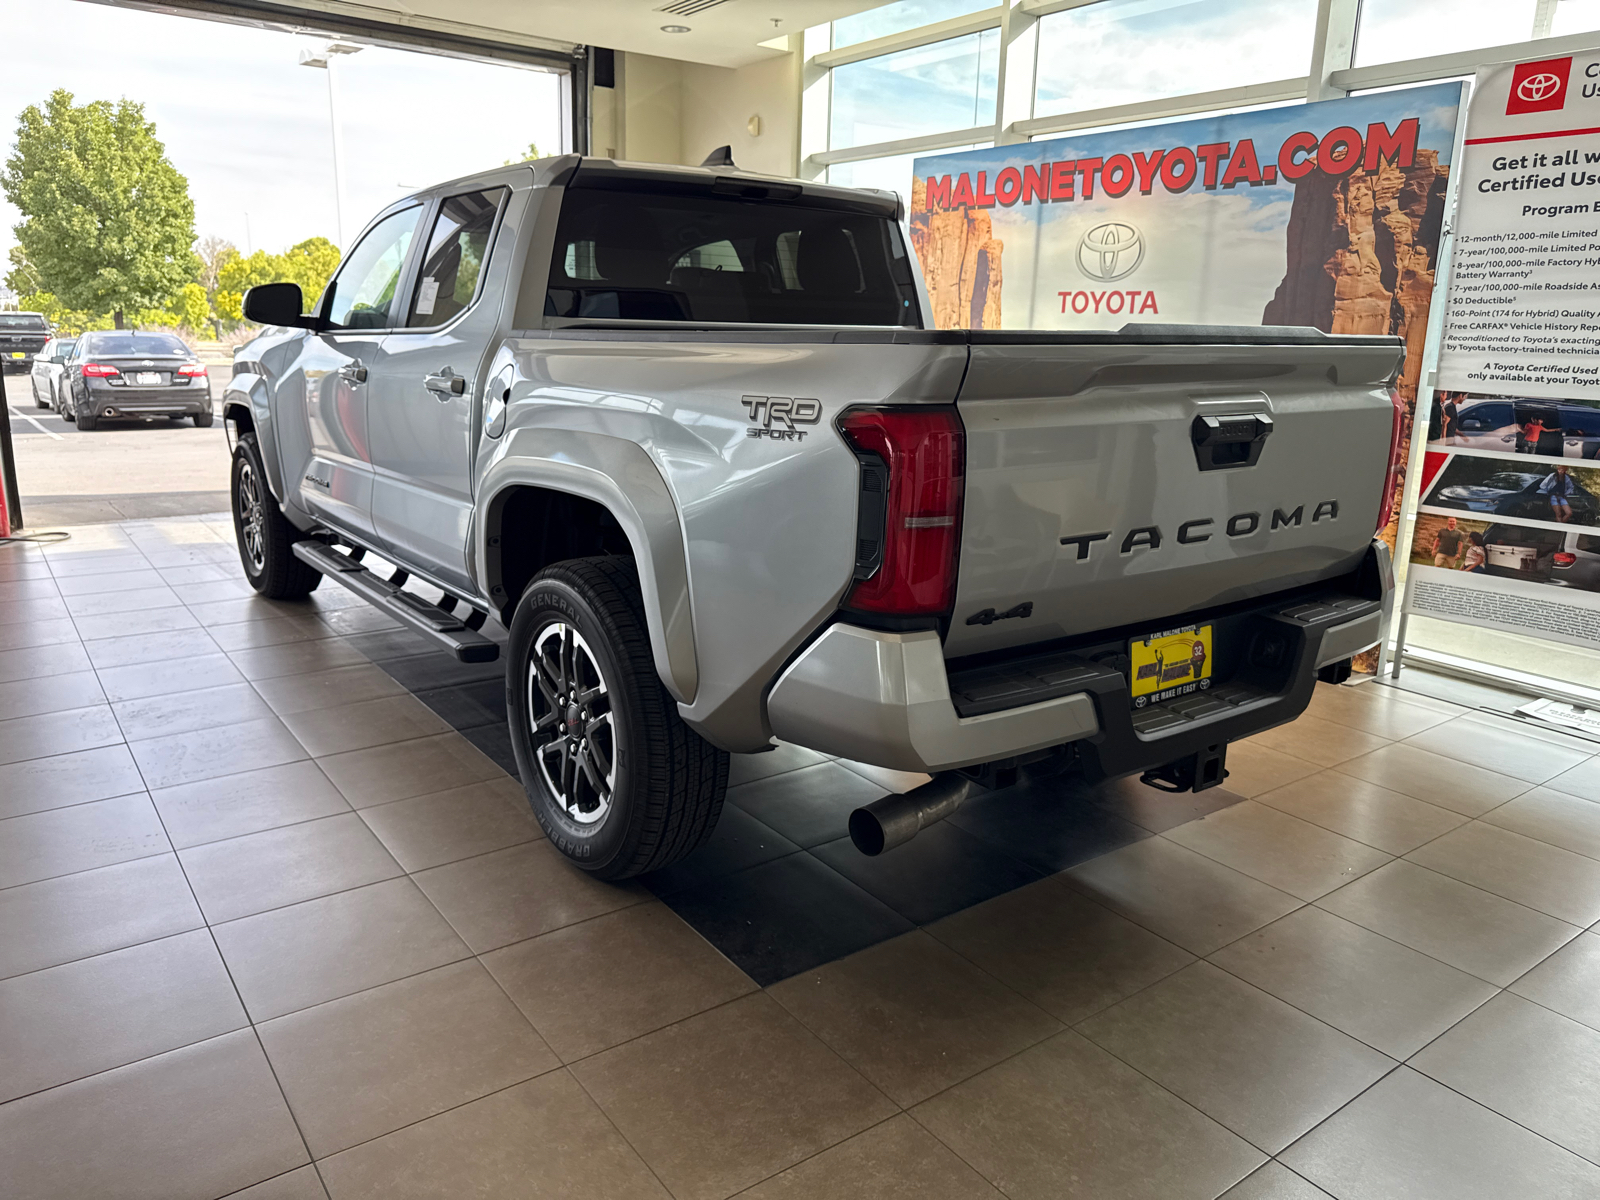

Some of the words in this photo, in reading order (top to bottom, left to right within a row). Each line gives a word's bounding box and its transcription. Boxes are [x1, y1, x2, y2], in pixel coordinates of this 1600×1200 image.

[1585, 63, 1600, 78] C
[926, 118, 1420, 212] MALONETOYOTA.COM
[1492, 155, 1528, 171] Get
[1532, 152, 1548, 168] it
[1551, 149, 1578, 166] all
[1478, 172, 1566, 193] Certified
[1570, 171, 1600, 187] Us
[1522, 203, 1589, 218] Program
[1460, 231, 1560, 243] 12-month/12,000-mile
[1561, 229, 1598, 239] Limited
[1459, 245, 1549, 258] 7-year/100,000-mile
[1550, 243, 1587, 253] Limited
[1456, 258, 1546, 271] 8-year/100,000-mile
[1547, 258, 1583, 268] Factory
[1455, 272, 1488, 280] Battery
[1454, 283, 1543, 294] 7-year/100,000-mile
[1544, 282, 1589, 291] Roadside
[1057, 290, 1159, 315] TOYOTA
[1452, 297, 1464, 305] $0
[1451, 309, 1491, 317] 160-Point
[1491, 309, 1510, 318] (174
[1511, 309, 1525, 317] for
[1525, 309, 1560, 319] Hybrid)
[1560, 309, 1596, 320] Quality
[1449, 322, 1468, 330] Free
[1509, 322, 1543, 331] Vehicle
[1544, 322, 1579, 333] History
[1580, 323, 1600, 333] Rep
[1447, 334, 1511, 343] Reconditioned
[1511, 335, 1521, 343] to
[1560, 336, 1600, 347] exacting
[1446, 343, 1457, 352] by
[1458, 344, 1486, 352] Toyota
[1488, 344, 1555, 354] factory-trained
[1483, 362, 1491, 370] A
[1493, 362, 1525, 372] Toyota
[1526, 364, 1571, 374] Certified
[1572, 365, 1599, 375] Used
[1467, 371, 1488, 382] only
[1489, 372, 1533, 382] available
[1534, 375, 1545, 383] at
[1546, 376, 1570, 385] your
[741, 395, 823, 430] TRD
[746, 427, 808, 442] SPORT
[1059, 499, 1341, 563] TACOMA
[530, 593, 583, 629] GENERAL
[1194, 646, 1202, 656] 32
[1151, 693, 1160, 703] WE
